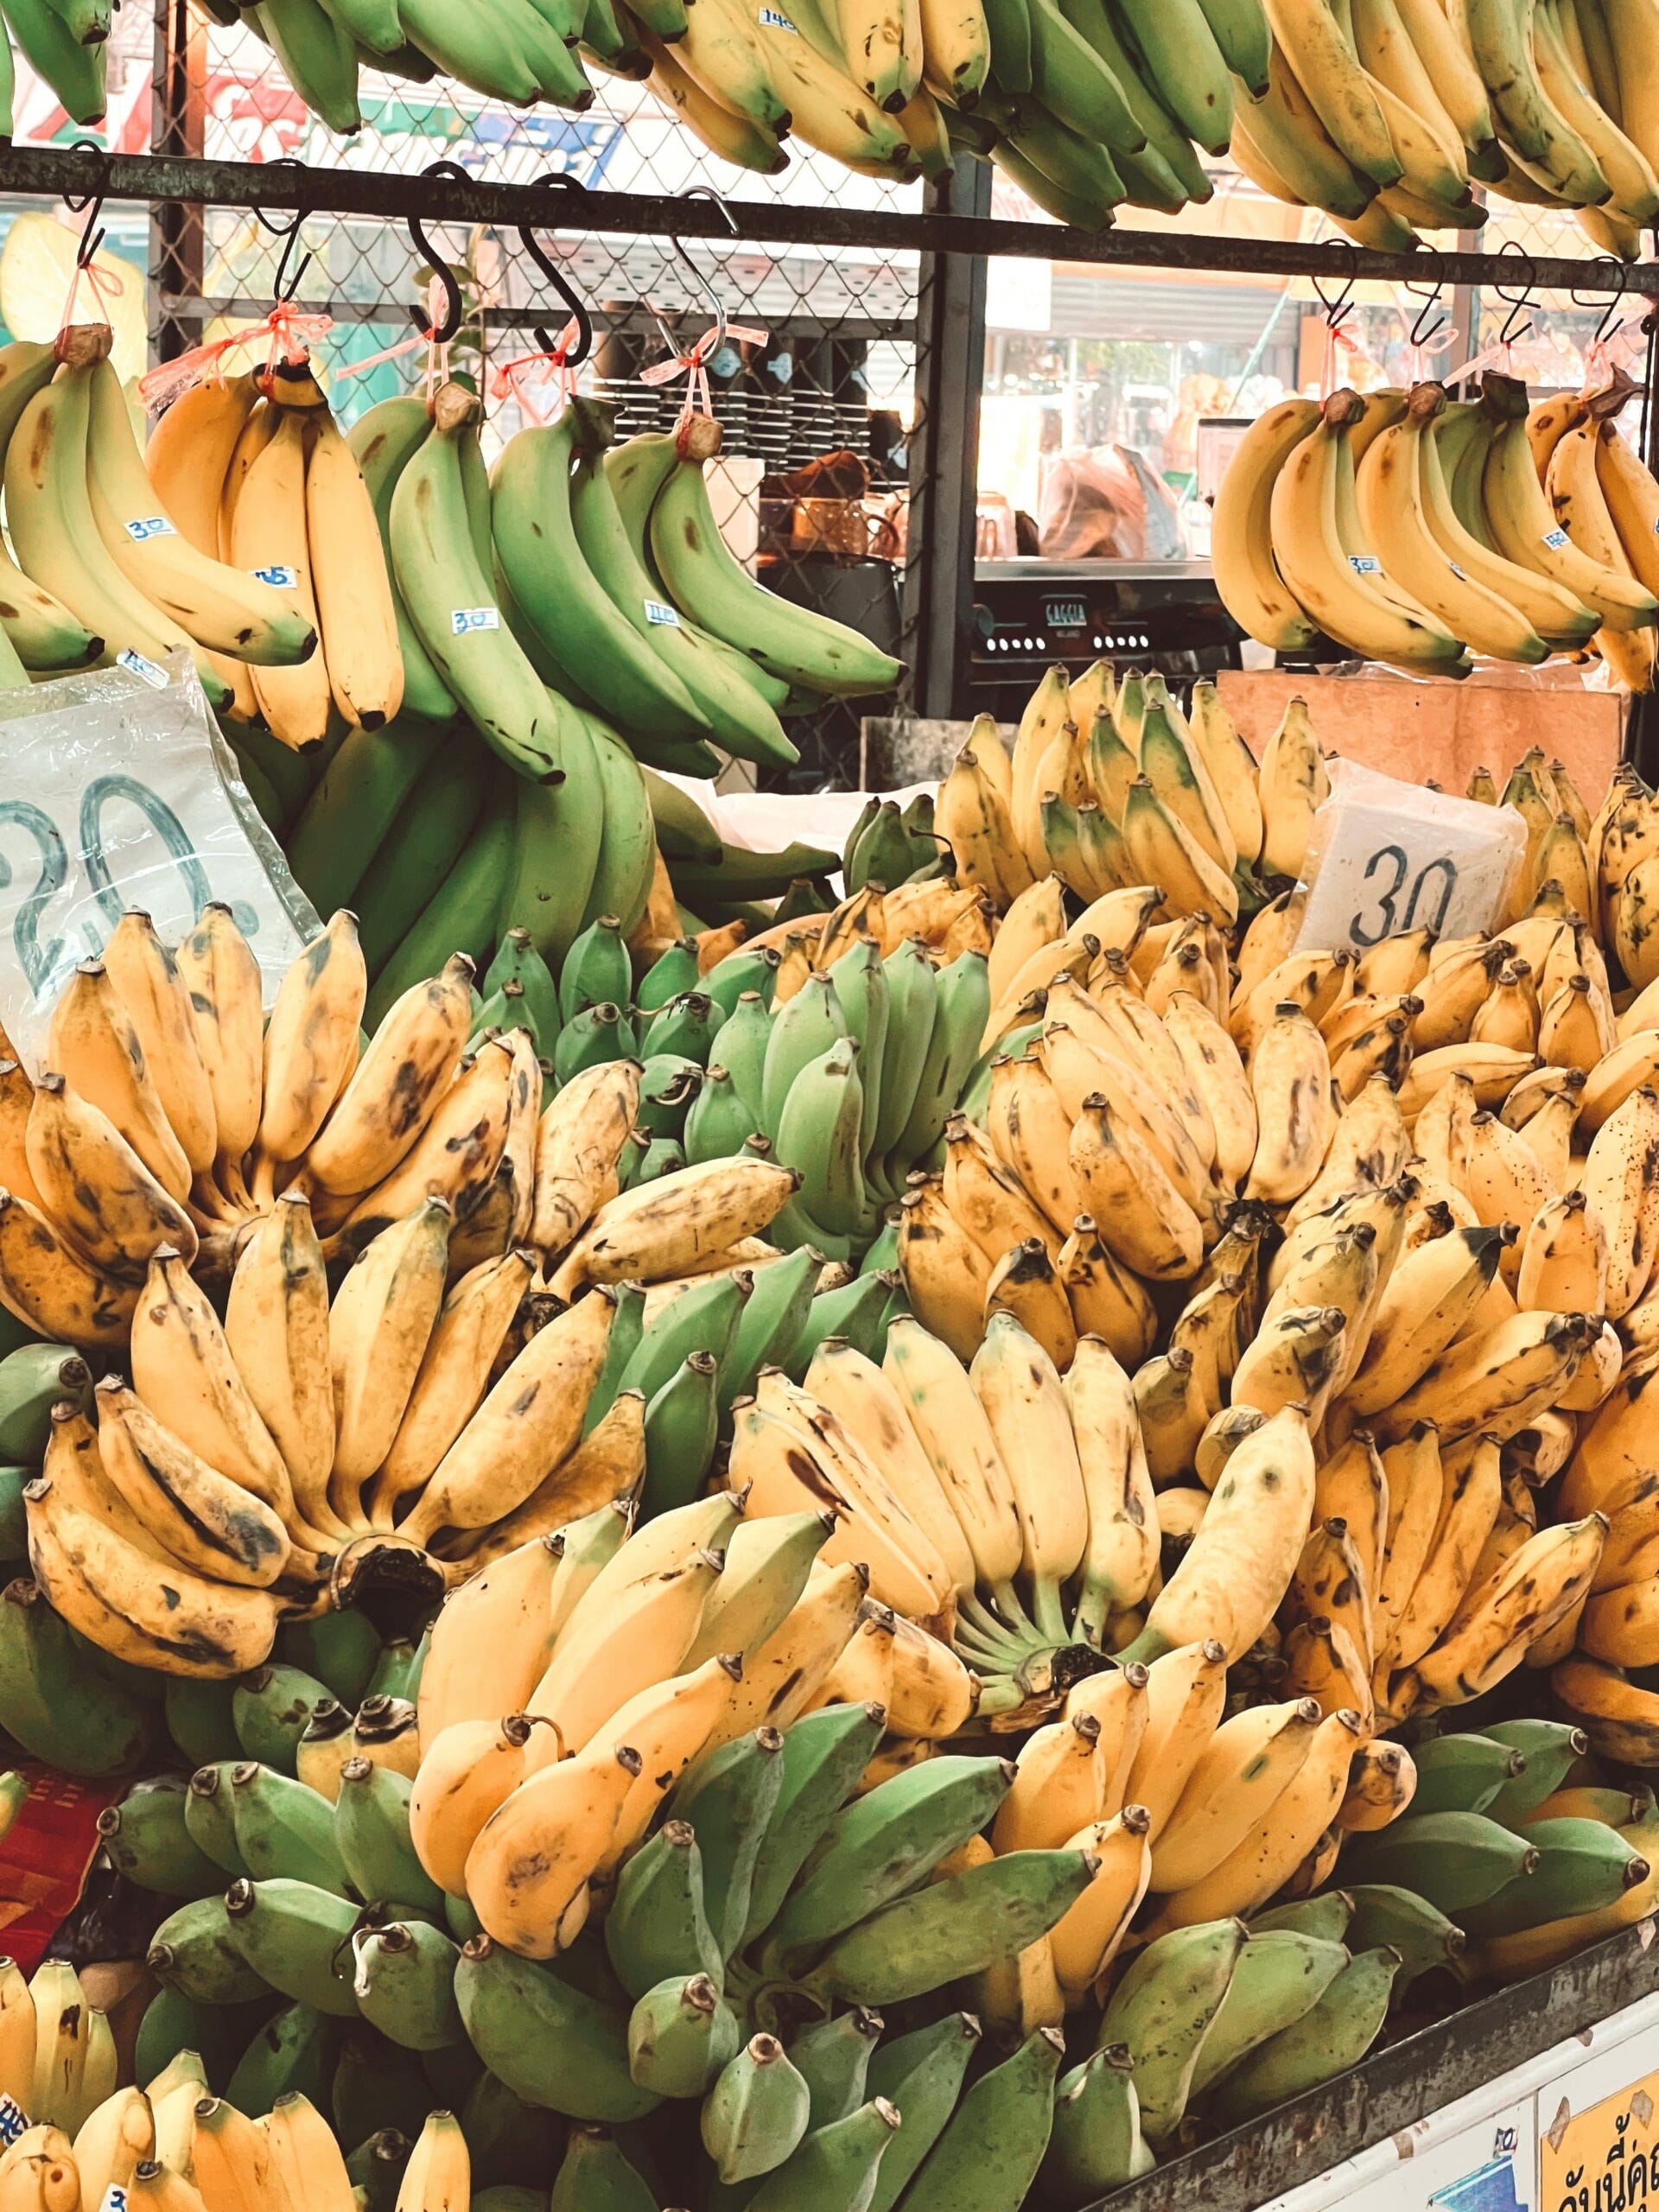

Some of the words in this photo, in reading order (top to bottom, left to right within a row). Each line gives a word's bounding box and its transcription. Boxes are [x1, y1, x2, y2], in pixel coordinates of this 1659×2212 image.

[129, 518, 163, 539] 30
[1351, 557, 1374, 574] 30
[454, 612, 486, 635] 30
[1349, 844, 1457, 947] 30
